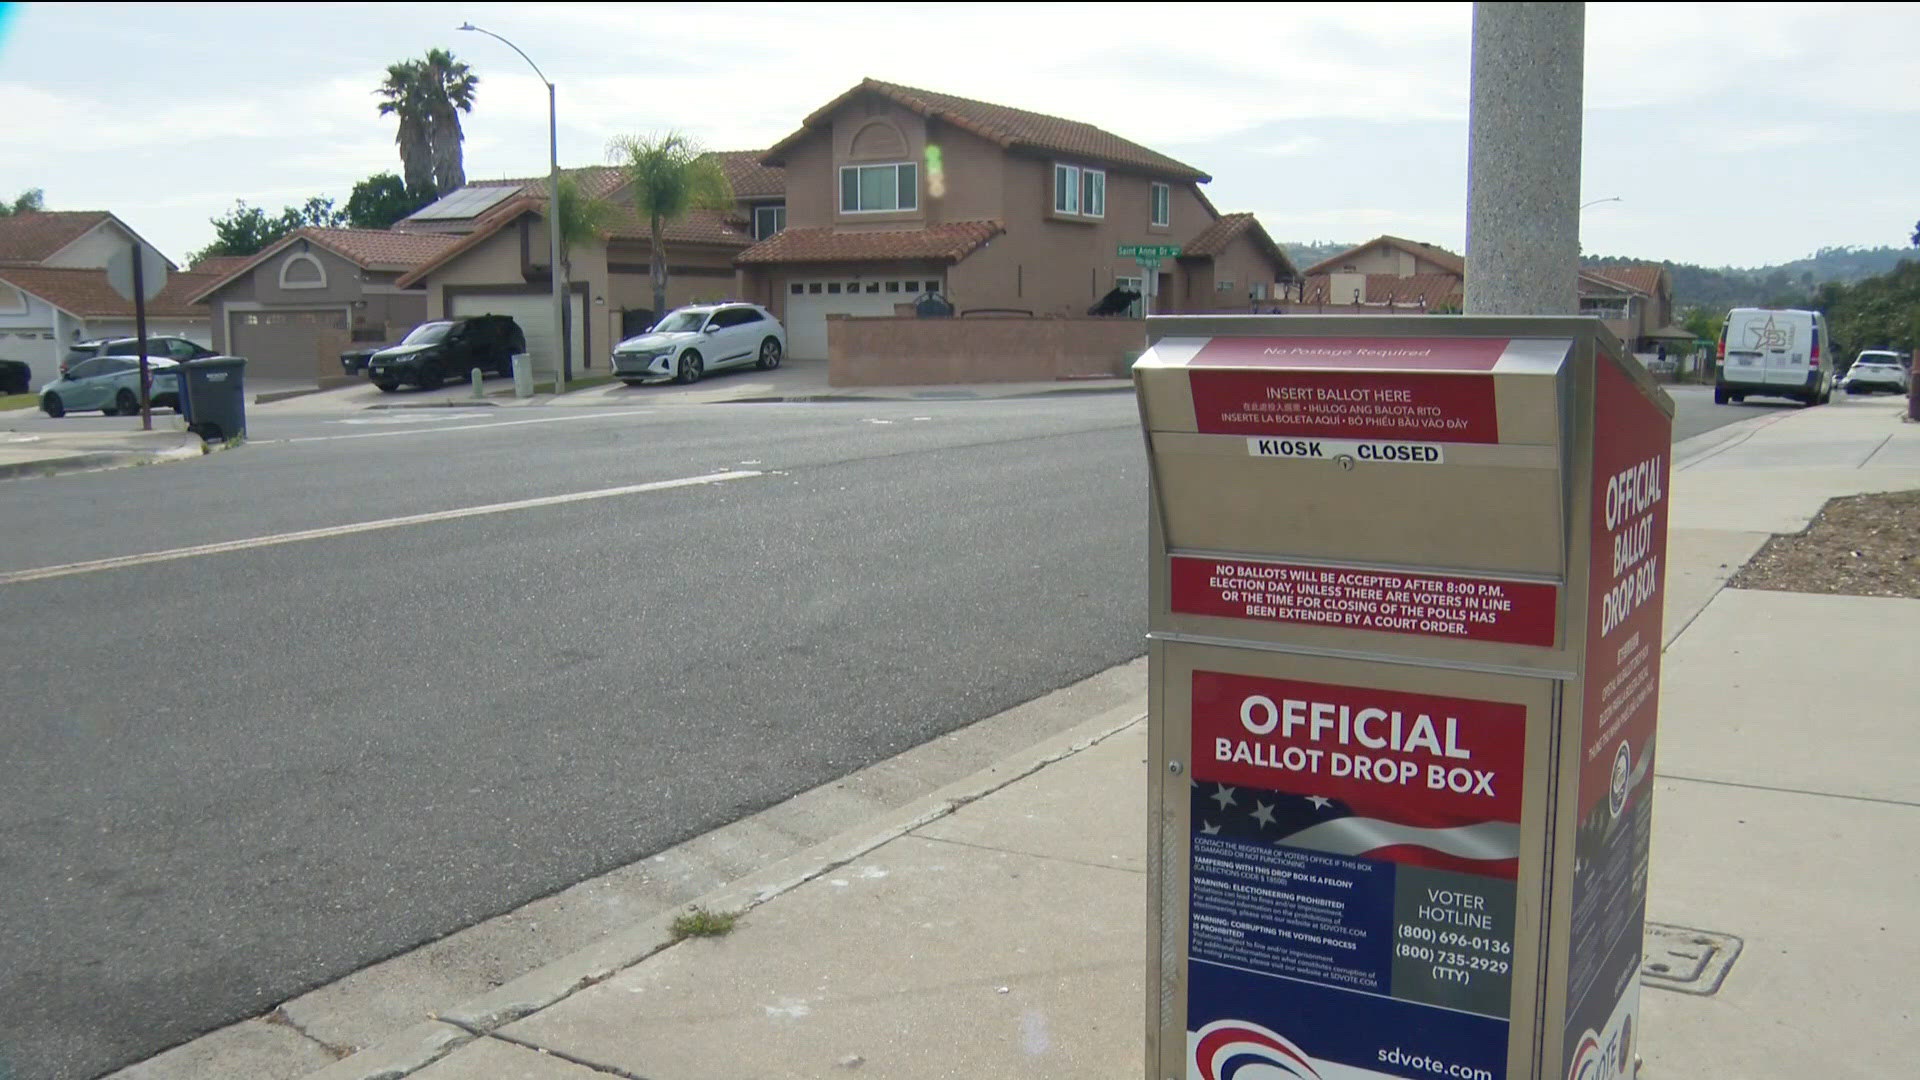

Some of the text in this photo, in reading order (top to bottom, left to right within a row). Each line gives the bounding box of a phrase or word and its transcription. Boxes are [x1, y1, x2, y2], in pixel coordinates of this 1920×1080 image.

[1118, 246, 1136, 256] Saint
[1138, 246, 1156, 256] Anne
[1159, 246, 1167, 256] Dr
[1263, 347, 1431, 358] No Postage Required
[1266, 387, 1412, 402] INSERT BALLOT HERE
[1221, 412, 1259, 423] INSERTE
[1261, 414, 1274, 423] LA
[1276, 414, 1313, 424] BOLETA
[1309, 404, 1441, 416] IHULOG ANG BALOTA RITO
[1259, 439, 1439, 462] KIOSK CLOSED
[1605, 454, 1662, 532] OFFICIAL
[1613, 513, 1653, 578] BALLOT
[1210, 577, 1511, 611] ELECTION DAY, UNLESS THERE ARE VOTERS IN LINE
[1216, 565, 1504, 597] NO BALLOTS WILL BE ACCEPTED AFTER 8:00 P.M.
[1222, 590, 1496, 624] OR THE TIME FOR CLOSING OF THE POLLS HAS
[1601, 556, 1657, 638] DROP BOX
[1246, 605, 1468, 634] BEEN EXTENDED BY A COURT ORDER.
[1240, 695, 1471, 760] OFFICIAL
[1216, 737, 1495, 797] BALLOT DROP BOX
[1194, 837, 1224, 847] CONTACT
[1238, 844, 1272, 855] REGISTRAR
[1283, 851, 1308, 861] VOTERS
[1309, 856, 1333, 865] OFFICE
[1341, 861, 1355, 869] THIS
[1357, 863, 1372, 872] BOX
[1201, 845, 1233, 856] DAMAGED
[1234, 850, 1243, 858] OR
[1245, 852, 1258, 860] NOT
[1259, 854, 1305, 868] FUNCTIONING
[1194, 855, 1233, 868] TAMPERING
[1234, 862, 1253, 872] WITH
[1254, 865, 1270, 874] THIS
[1271, 868, 1291, 878] DROP
[1293, 872, 1308, 881] BOX
[1324, 877, 1352, 888] FELONY
[1205, 865, 1239, 877] ELECTIONS
[1240, 871, 1258, 880] CODE
[1193, 877, 1344, 909] WARNING: ELECTIONEERING PROHIBITED!
[1428, 888, 1484, 910] VOTER
[1192, 913, 1356, 950] WARNING: CORRUPTING THE VOTING PROCESS
[1200, 923, 1244, 937] PROHIBITED!
[1319, 923, 1367, 937] SDVOTE.COM
[1418, 905, 1492, 930] HOTLINE
[1398, 924, 1510, 955] (800) 696-0136
[1396, 943, 1509, 974] (800) 735-2929
[1330, 970, 1377, 986] SDVOTE.COM
[1432, 966, 1470, 985] (TTY)
[1378, 1047, 1492, 1080] sdvote.com
